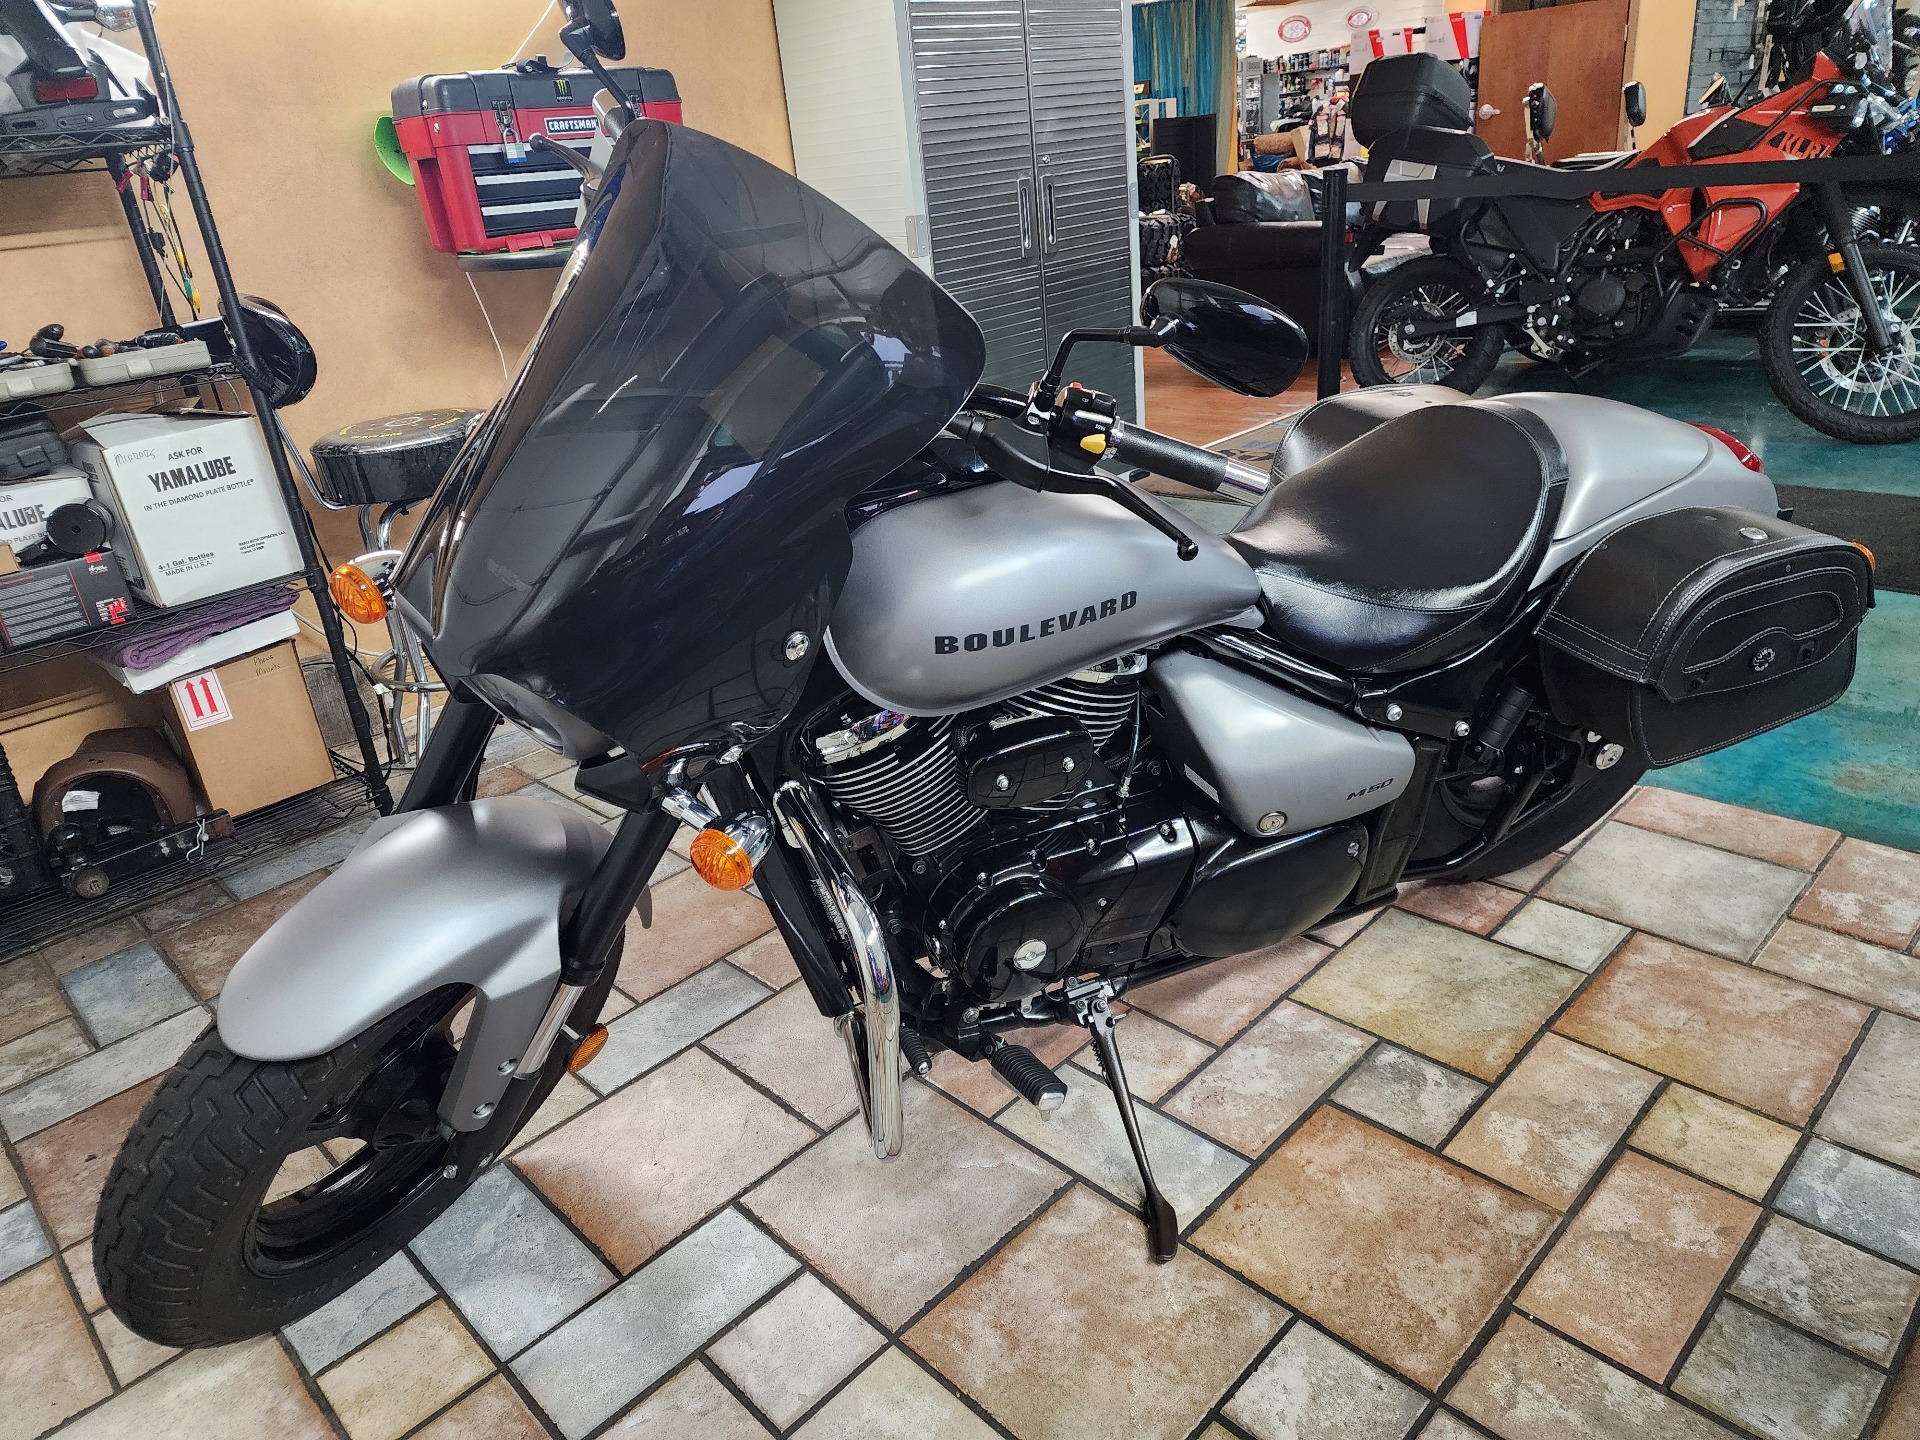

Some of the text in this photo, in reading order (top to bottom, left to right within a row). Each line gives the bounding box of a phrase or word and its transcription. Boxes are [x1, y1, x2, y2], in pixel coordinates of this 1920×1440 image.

[548, 119, 597, 131] CRAFTSMAN
[1778, 132, 1822, 160] KLR
[168, 446, 204, 461] ASK FOR
[147, 456, 237, 493] YAMALUBE
[143, 504, 153, 512] IN
[153, 501, 168, 510] THE
[168, 491, 205, 506] DIAMOND
[205, 485, 226, 497] PLATE
[157, 551, 215, 571] 4-1 Gal. Bottles
[165, 567, 185, 577] MADE
[185, 564, 193, 572] IN
[934, 590, 1138, 655] BOULEVARD
[1346, 777, 1395, 801] M50
